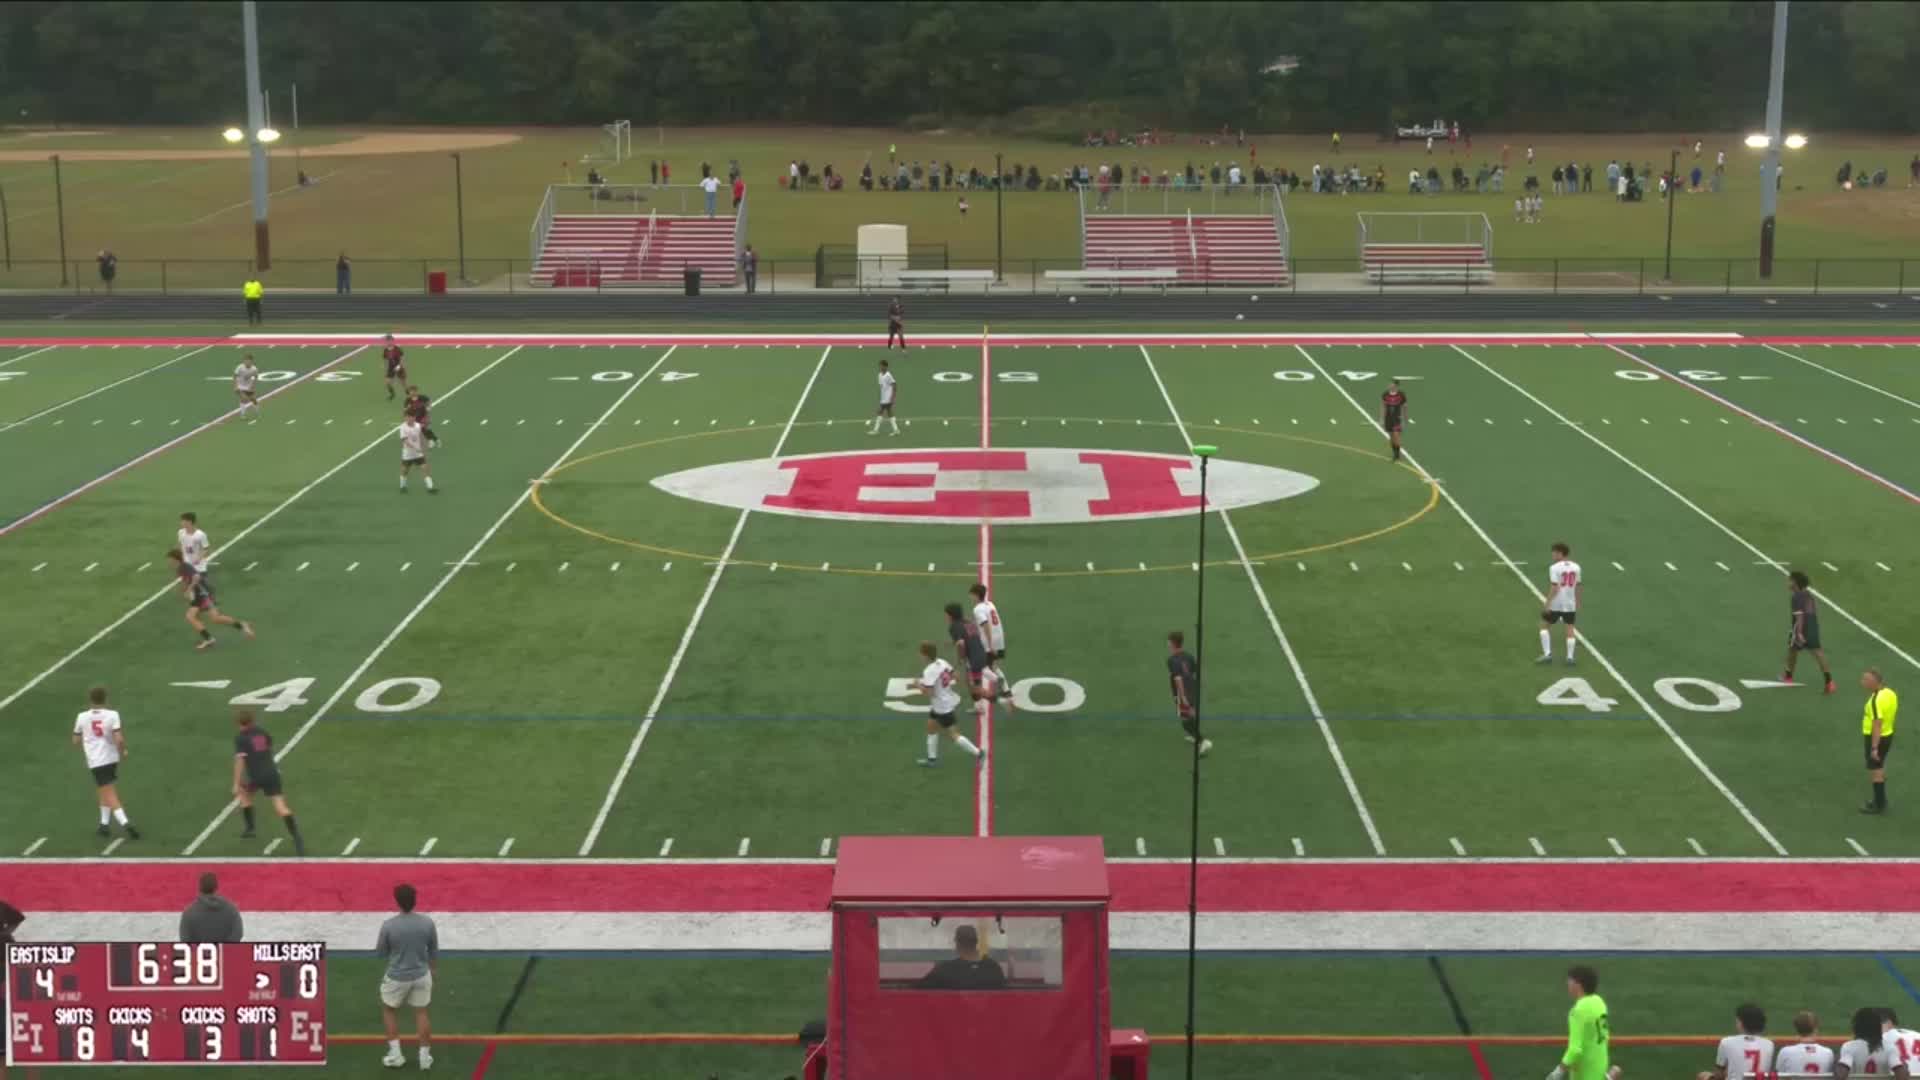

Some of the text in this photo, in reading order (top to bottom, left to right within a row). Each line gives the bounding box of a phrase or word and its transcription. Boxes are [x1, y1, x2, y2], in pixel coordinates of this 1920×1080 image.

[229, 677, 442, 712] 40
[1536, 677, 1743, 712] 40
[91, 720, 105, 738] 5
[1743, 1050, 1761, 1074] 7
